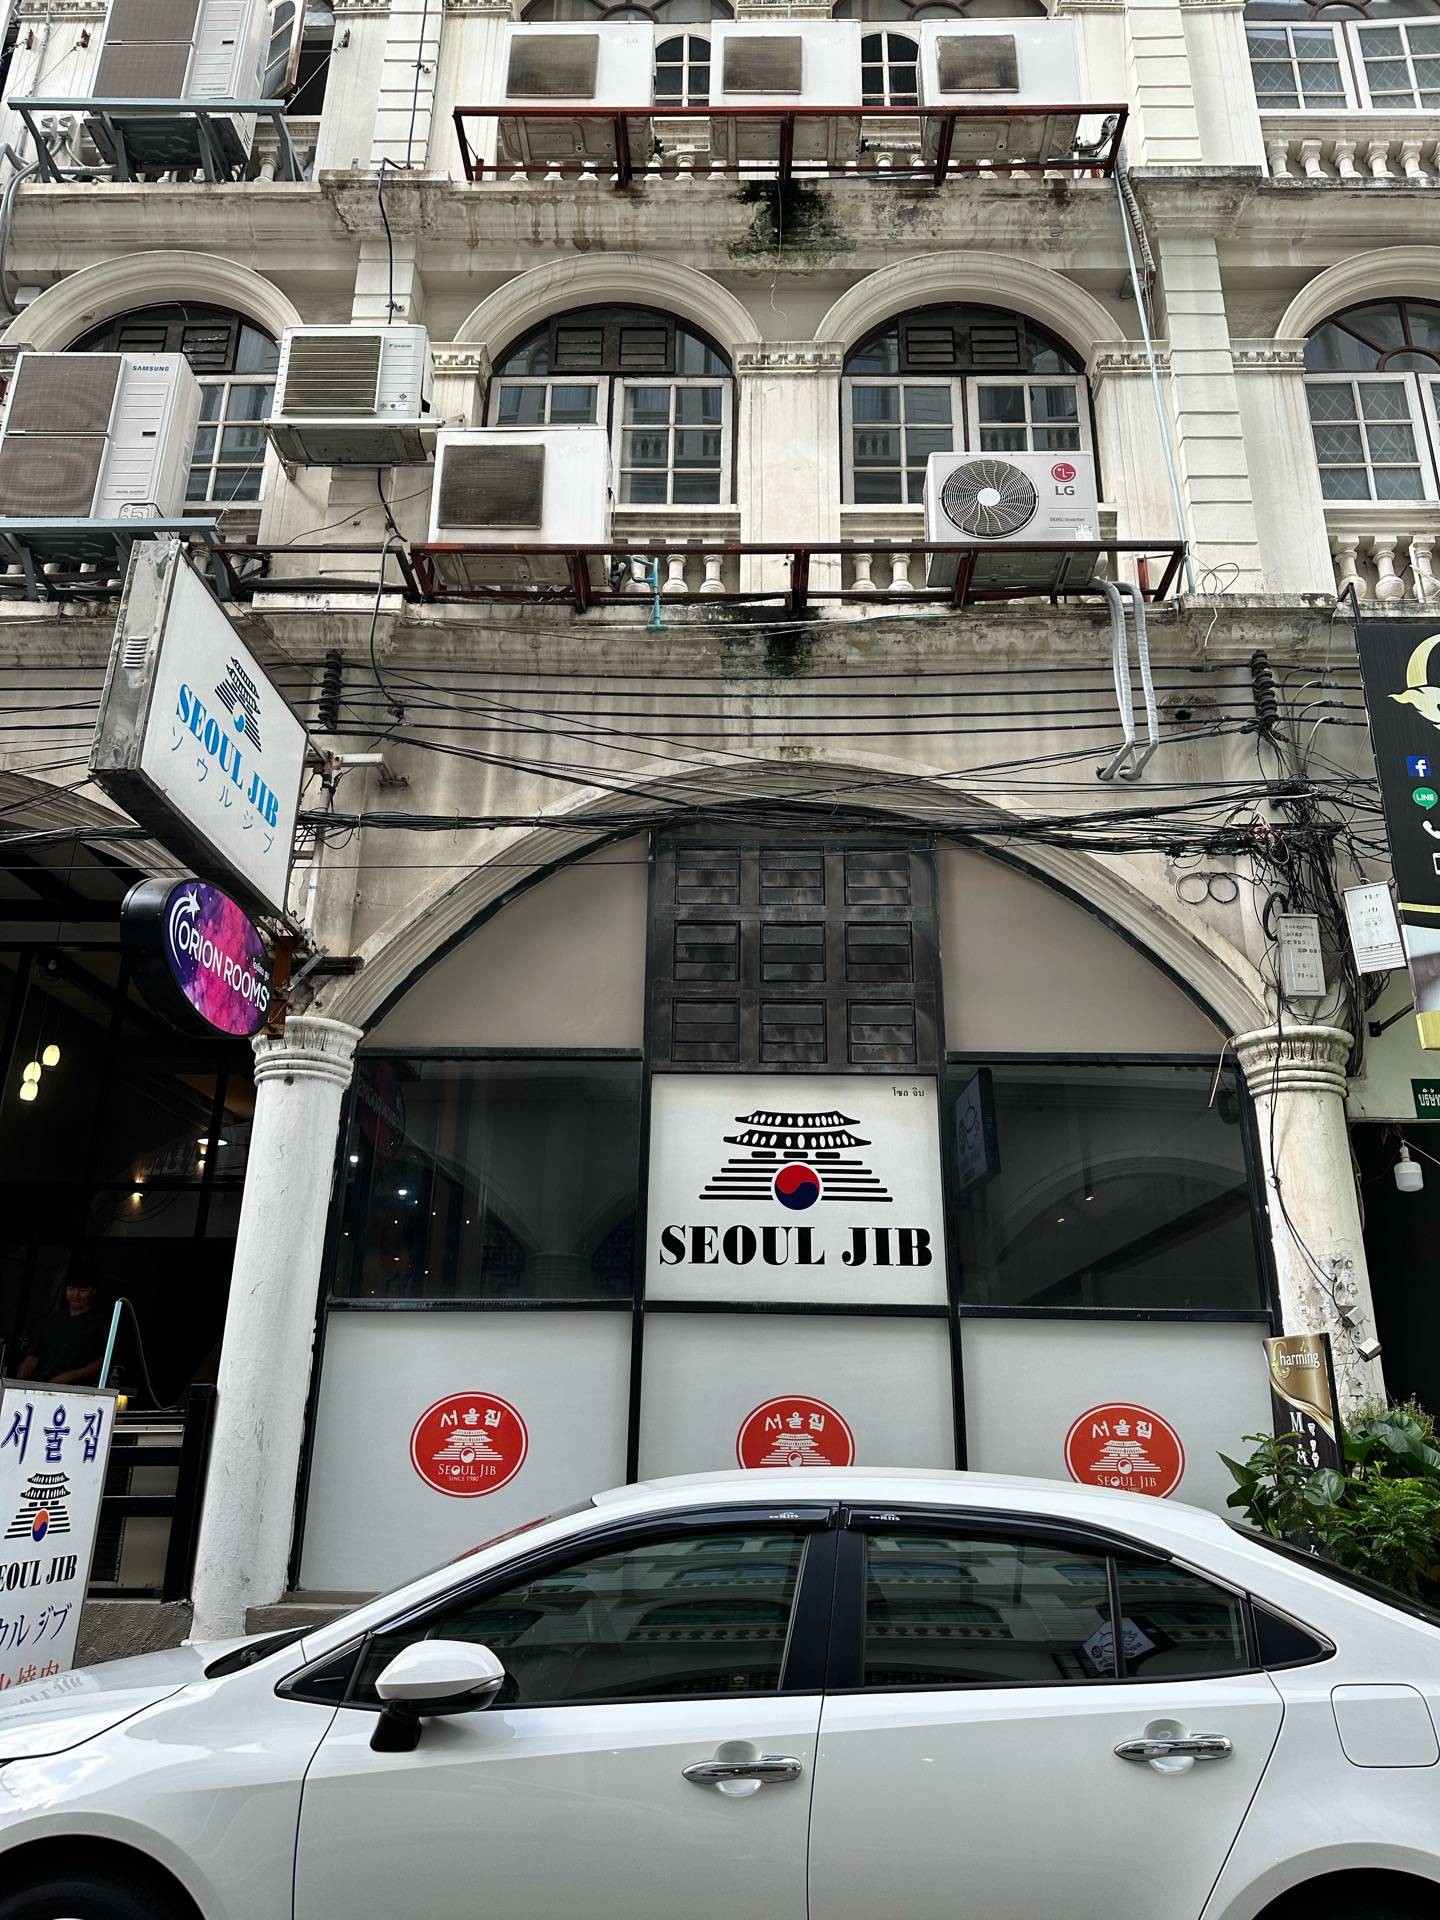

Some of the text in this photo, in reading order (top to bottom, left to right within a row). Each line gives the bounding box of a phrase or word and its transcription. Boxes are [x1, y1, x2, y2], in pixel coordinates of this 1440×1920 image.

[1055, 485, 1075, 496] LG
[175, 683, 280, 829] SEOUL JIB
[1415, 793, 1435, 801] LINE
[178, 920, 223, 977] ORION
[223, 955, 270, 1012] ROOMS
[659, 1224, 933, 1267] SEOUL JIB
[440, 1407, 501, 1428] 서울집
[764, 1411, 825, 1432] 서울집
[1, 1402, 104, 1465] 서울집
[1092, 1419, 1152, 1439] 서울집
[438, 1463, 476, 1475] SEOUL
[1097, 1474, 1136, 1487] SEOUL
[46, 1554, 78, 1585] JIB
